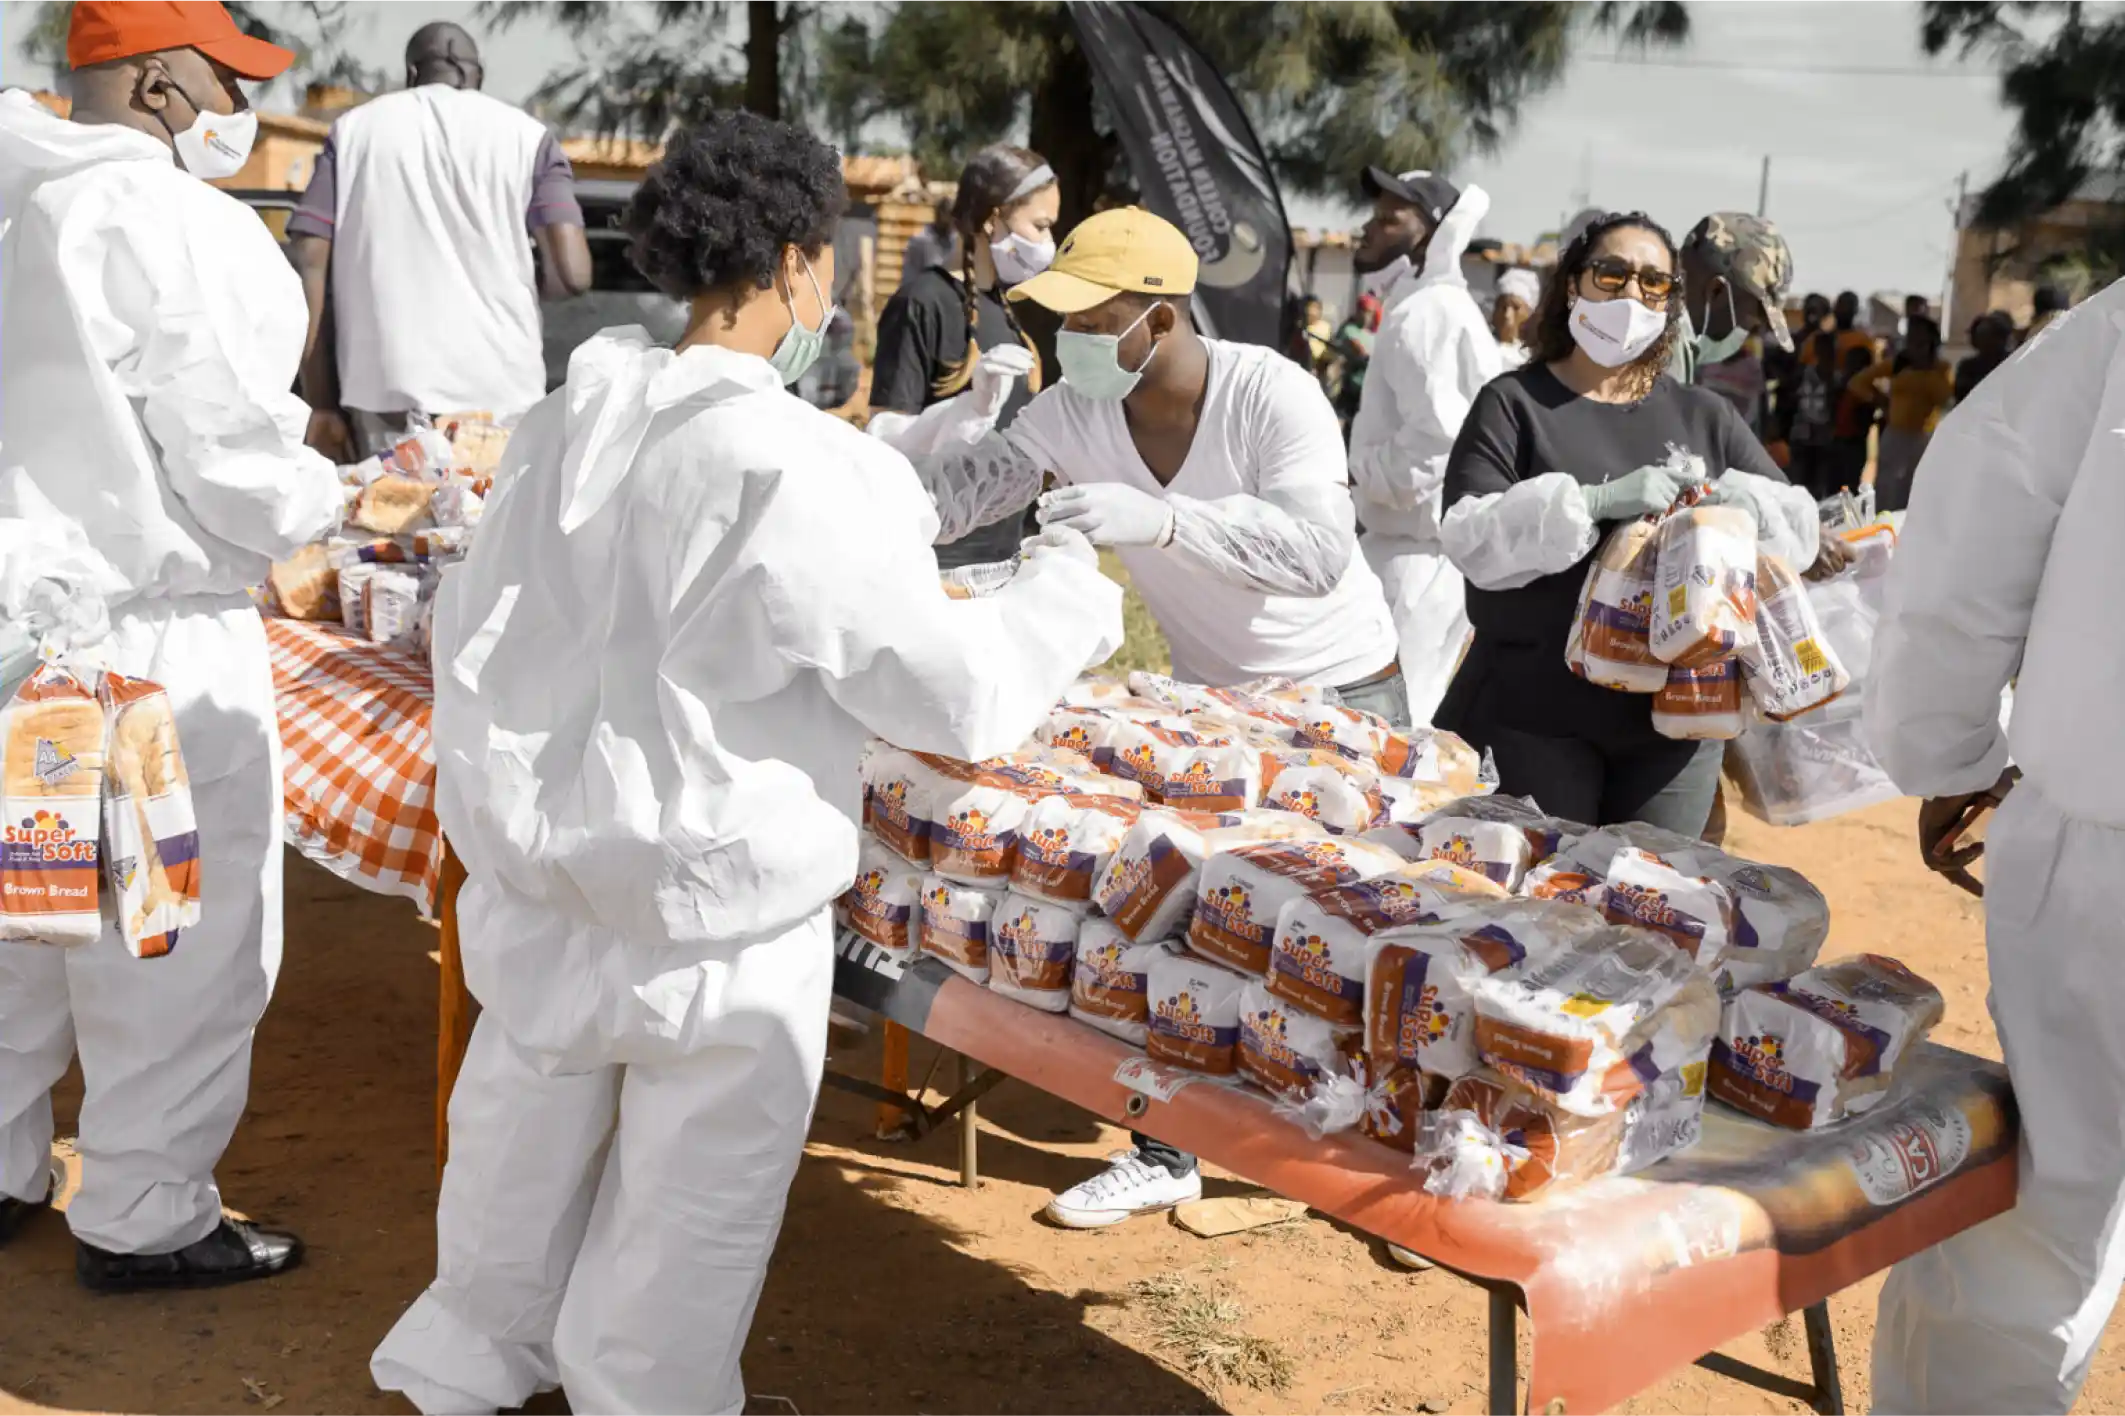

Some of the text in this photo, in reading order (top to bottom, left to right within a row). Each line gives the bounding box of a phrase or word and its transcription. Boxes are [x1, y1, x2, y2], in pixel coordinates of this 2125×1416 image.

[1051, 735, 1091, 749] Super
[1171, 773, 1212, 785] Super
[4, 825, 76, 848] Super
[43, 841, 97, 861] Soft
[4, 883, 89, 898] Brown Bread
[1206, 888, 1253, 920] Super
[1226, 916, 1264, 943] Soft
[1282, 936, 1333, 970] Super
[1303, 966, 1343, 995] Soft
[1156, 1000, 1201, 1026] Super
[1417, 984, 1439, 1048] Super
[1179, 1023, 1216, 1046] Soft
[1733, 1036, 1785, 1069] Super
[1755, 1065, 1794, 1094] Soft
